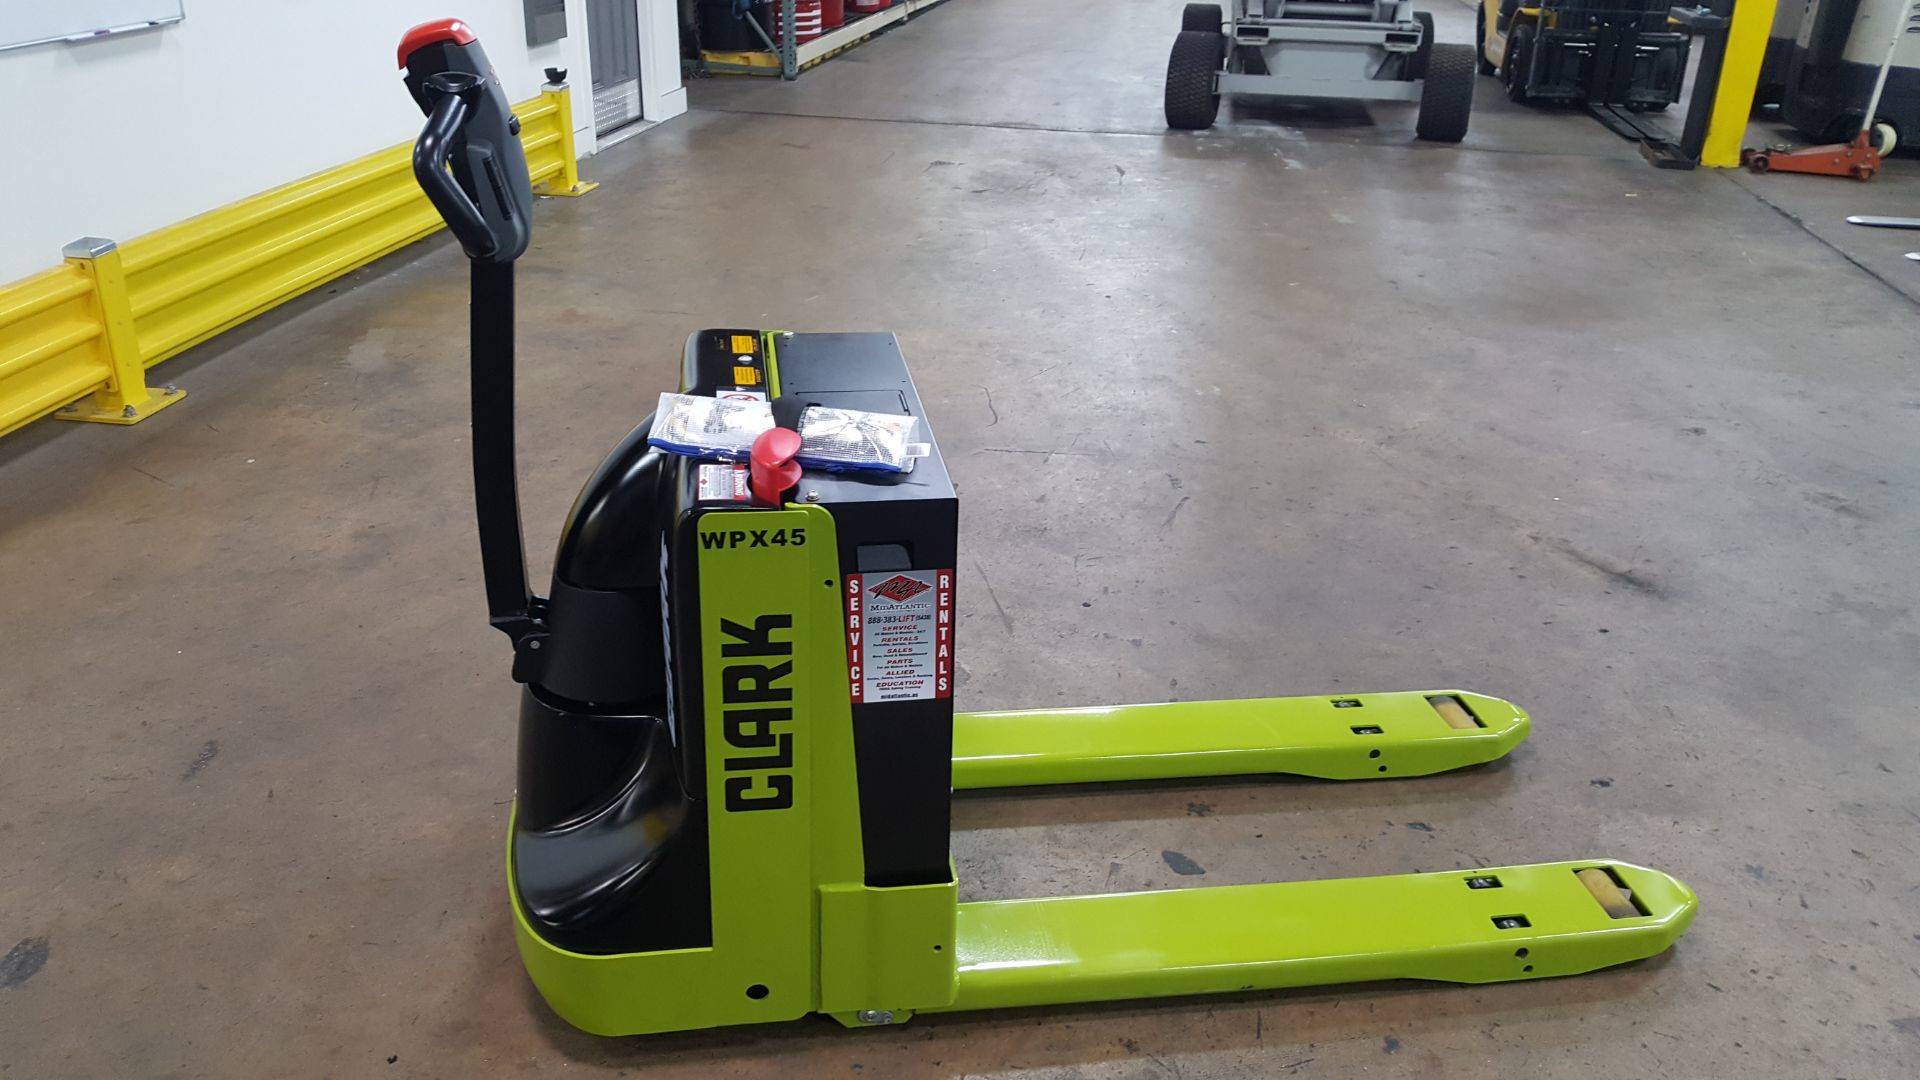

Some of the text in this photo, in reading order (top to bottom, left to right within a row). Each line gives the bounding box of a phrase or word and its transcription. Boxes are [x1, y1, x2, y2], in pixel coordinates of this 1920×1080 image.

[700, 528, 806, 550] WPX45
[850, 579, 861, 697] SERVICE
[881, 635, 919, 643] RENTALS
[882, 624, 918, 632] SERVICE
[938, 574, 950, 691] RENTALS
[876, 679, 924, 688] EDUCATION
[720, 614, 794, 812] CLARK
